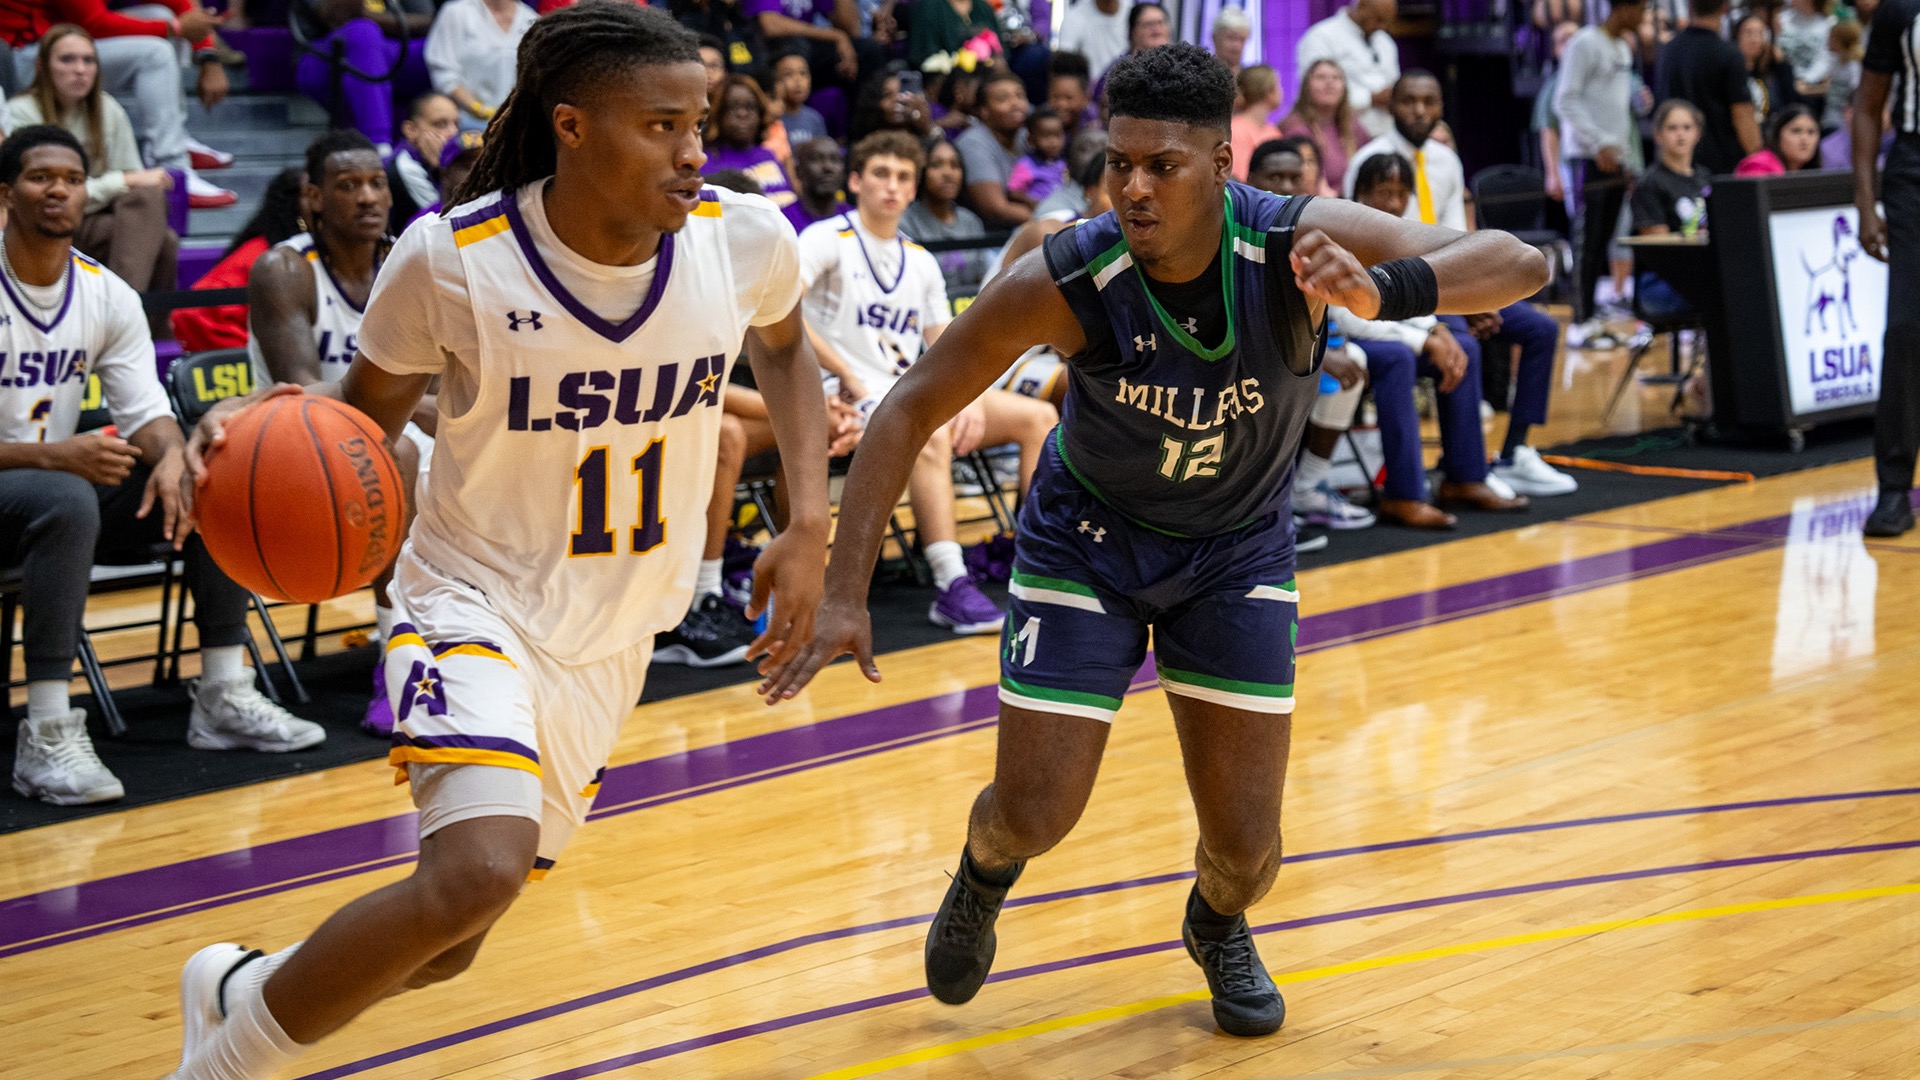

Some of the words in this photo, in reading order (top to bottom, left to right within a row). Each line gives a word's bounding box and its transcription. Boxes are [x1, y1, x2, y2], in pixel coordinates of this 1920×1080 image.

[0, 349, 87, 388] LSUA
[1810, 344, 1873, 383] LSUA
[508, 353, 726, 433] LSUA
[1156, 428, 1228, 484] 12
[567, 434, 668, 558] 11
